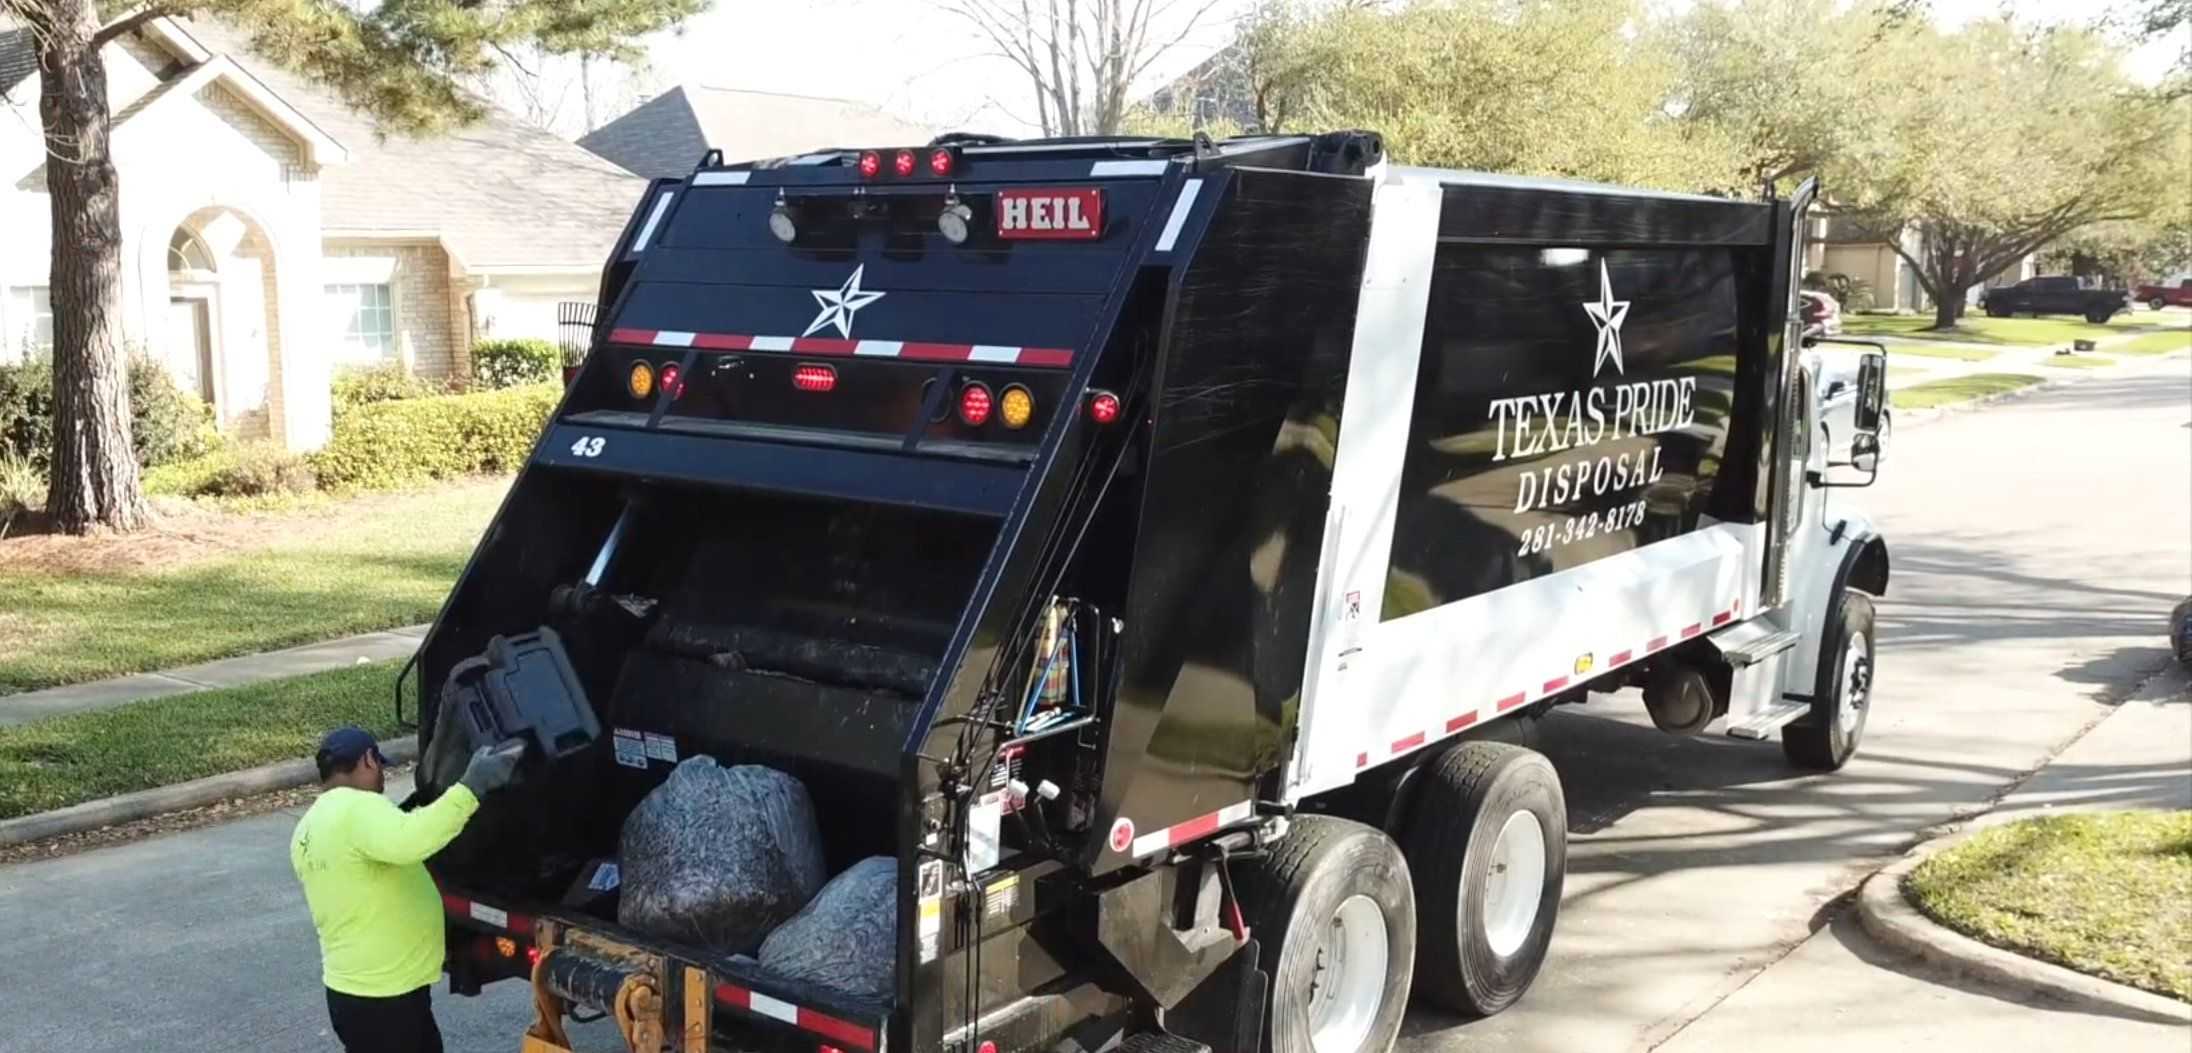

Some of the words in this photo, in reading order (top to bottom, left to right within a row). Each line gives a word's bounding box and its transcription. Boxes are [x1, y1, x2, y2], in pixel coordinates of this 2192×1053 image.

[1002, 197, 1090, 230] HEIL
[571, 436, 606, 457] 43
[1488, 387, 1605, 461] TEXAS
[1612, 377, 1696, 441] PRIDE
[1513, 446, 1664, 514] DISPOSAL
[1518, 501, 1647, 556] 281-342-8178
